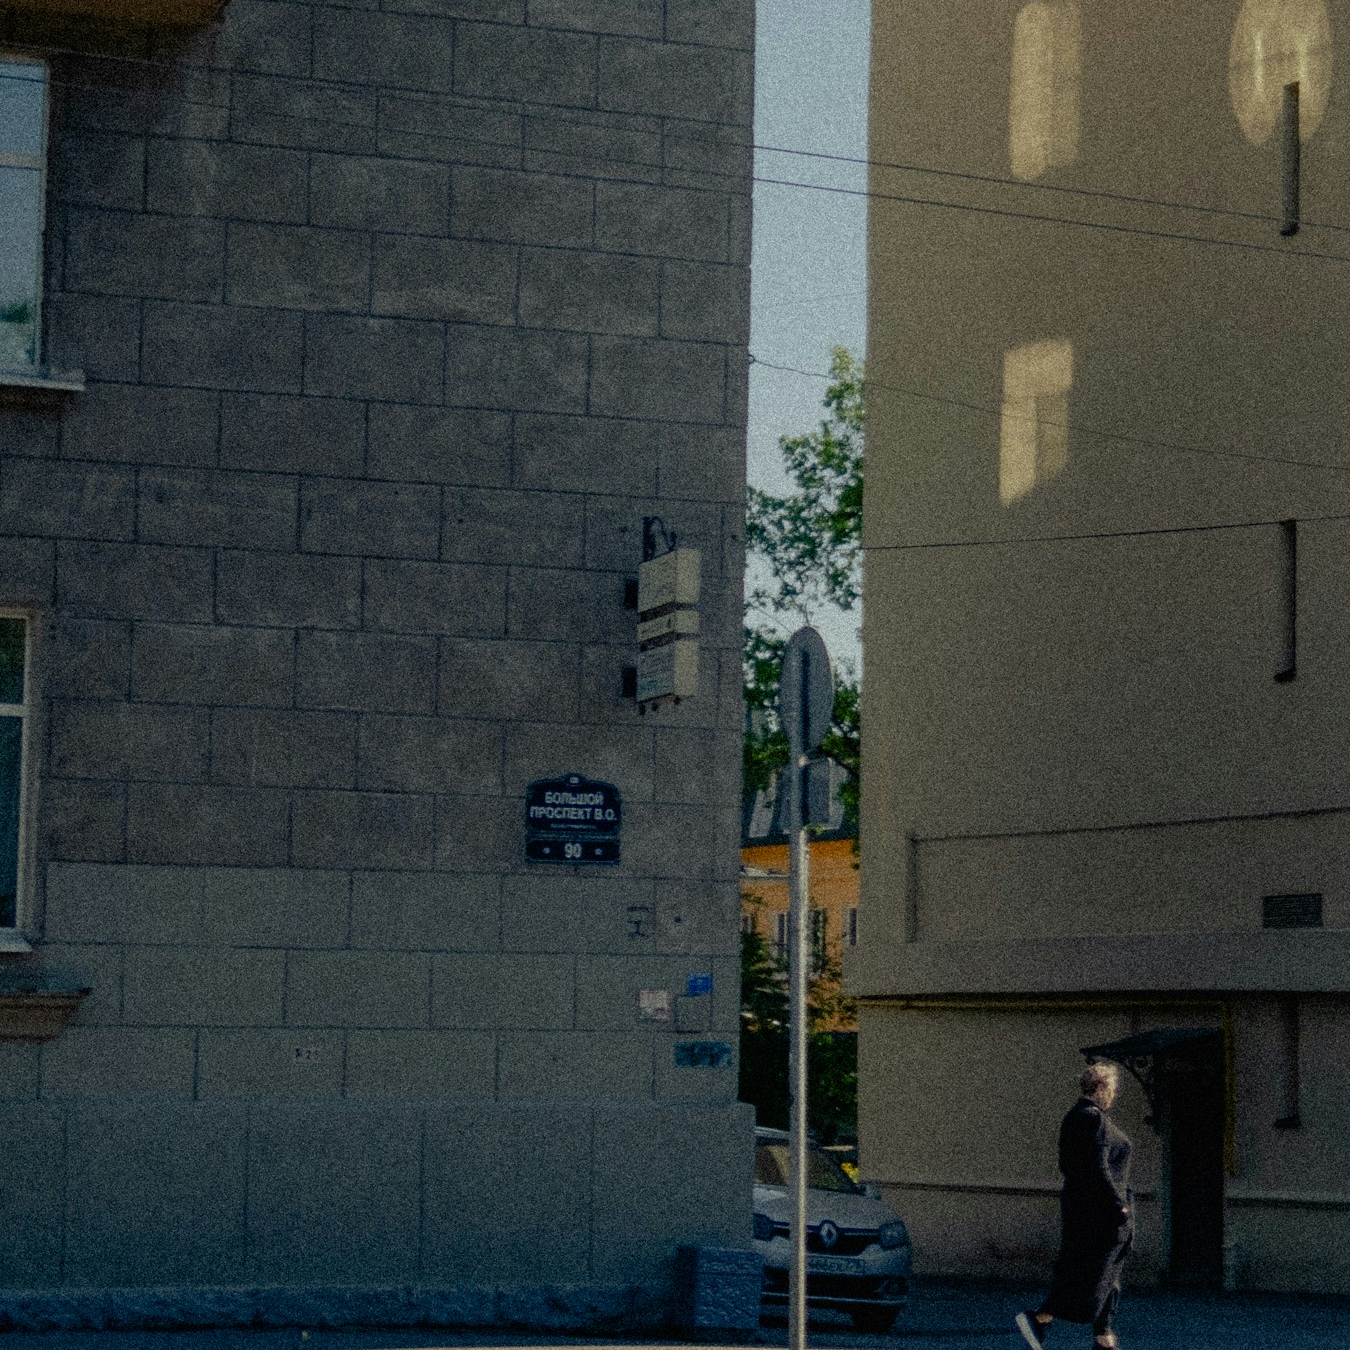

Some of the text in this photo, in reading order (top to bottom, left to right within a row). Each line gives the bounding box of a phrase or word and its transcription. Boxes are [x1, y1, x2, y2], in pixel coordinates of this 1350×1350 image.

[545, 792, 603, 805] БОЛЬШОЙ
[530, 807, 617, 820] ПРОСПЕКТ В.О.
